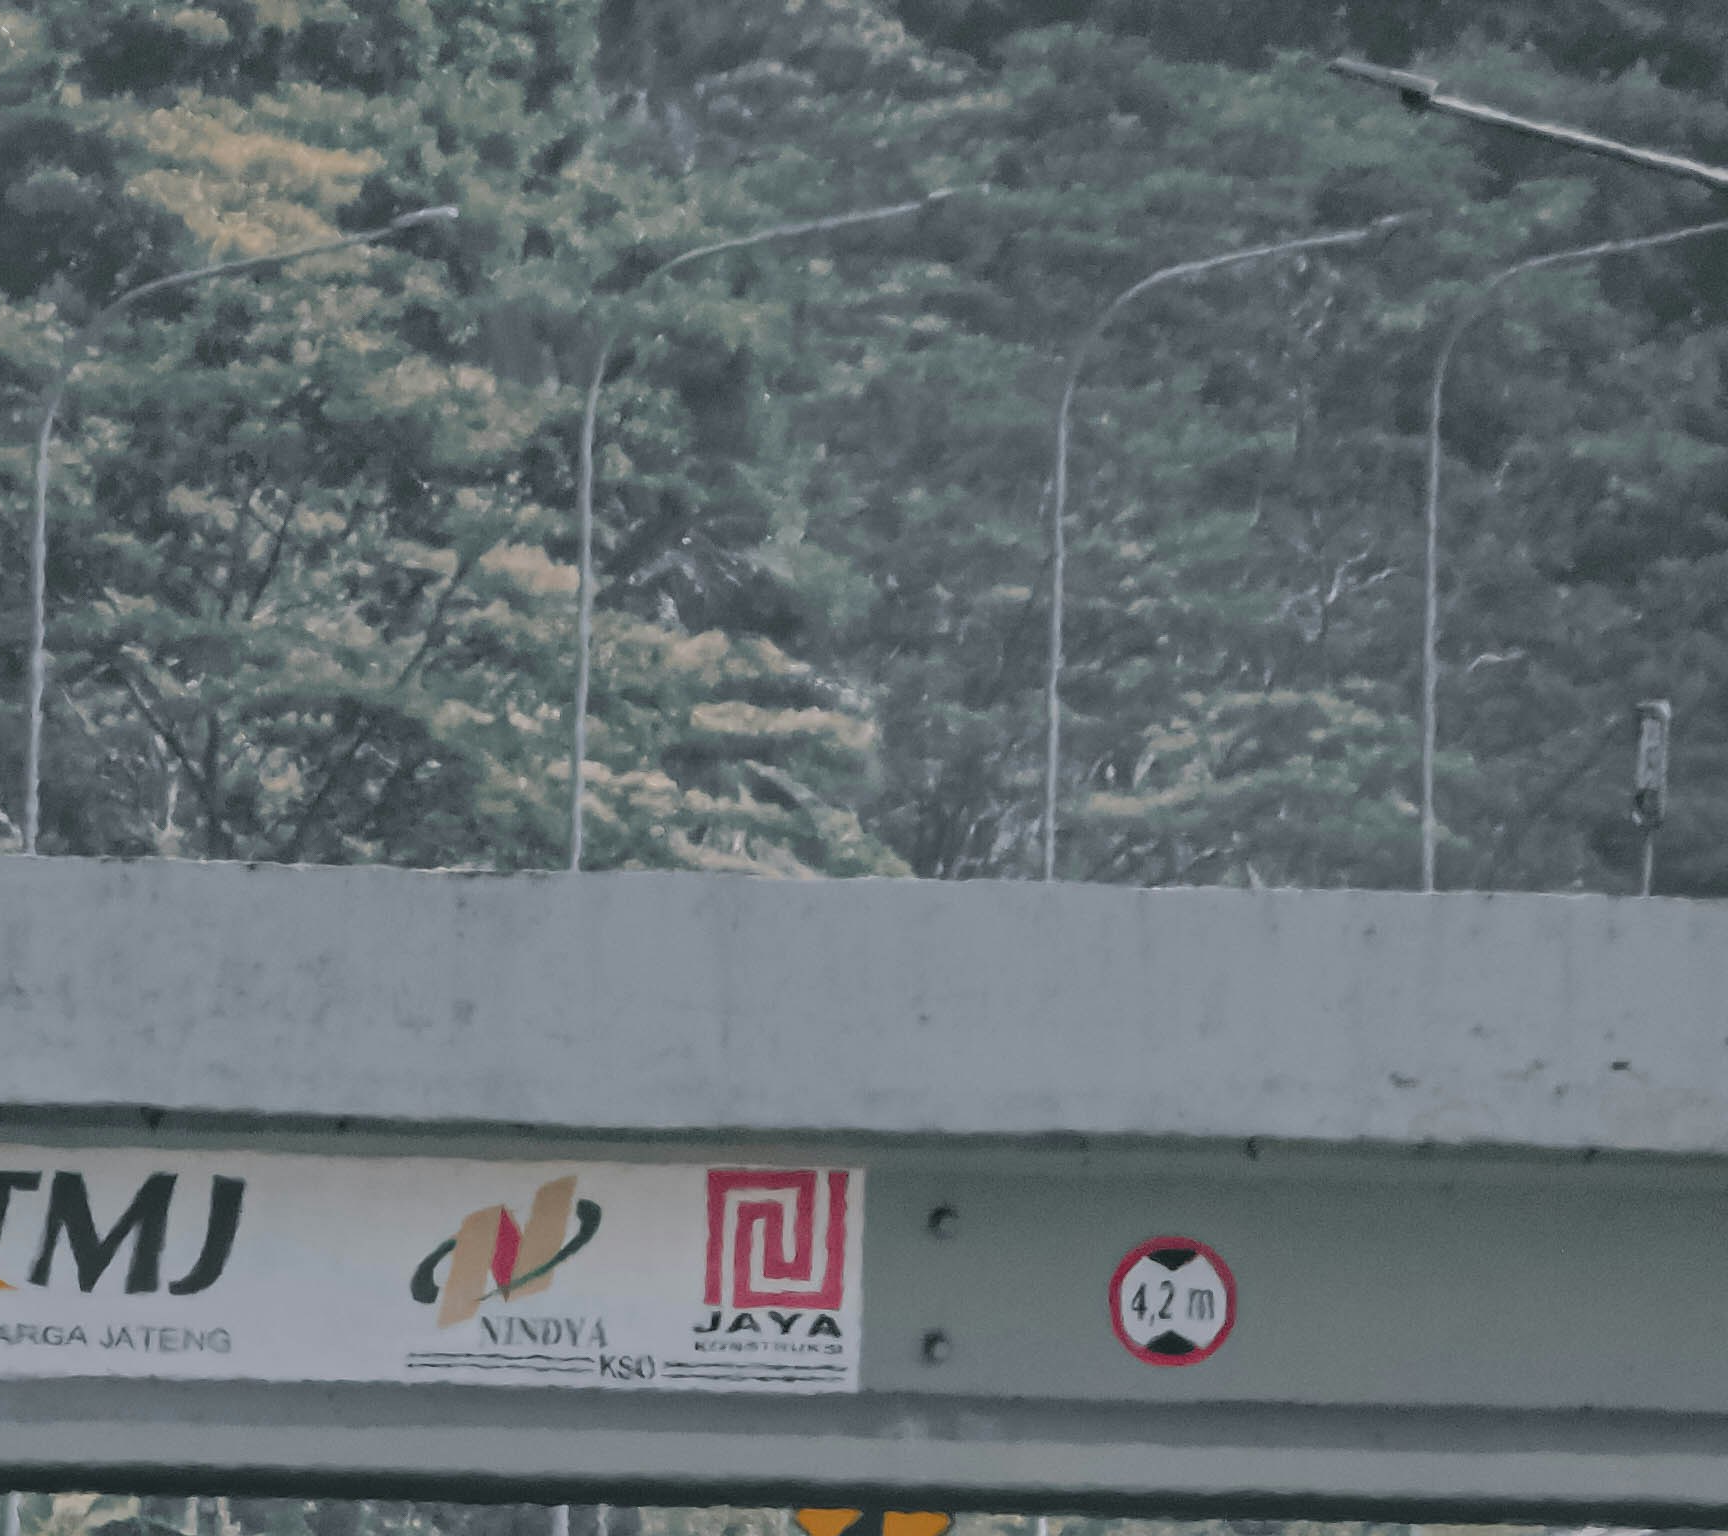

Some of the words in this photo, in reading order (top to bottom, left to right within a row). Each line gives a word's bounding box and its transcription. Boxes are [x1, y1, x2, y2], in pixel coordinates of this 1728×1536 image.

[478, 1315, 609, 1349] NINDYA
[693, 1310, 842, 1338] JAYA
[99, 1325, 232, 1354] JATENG
